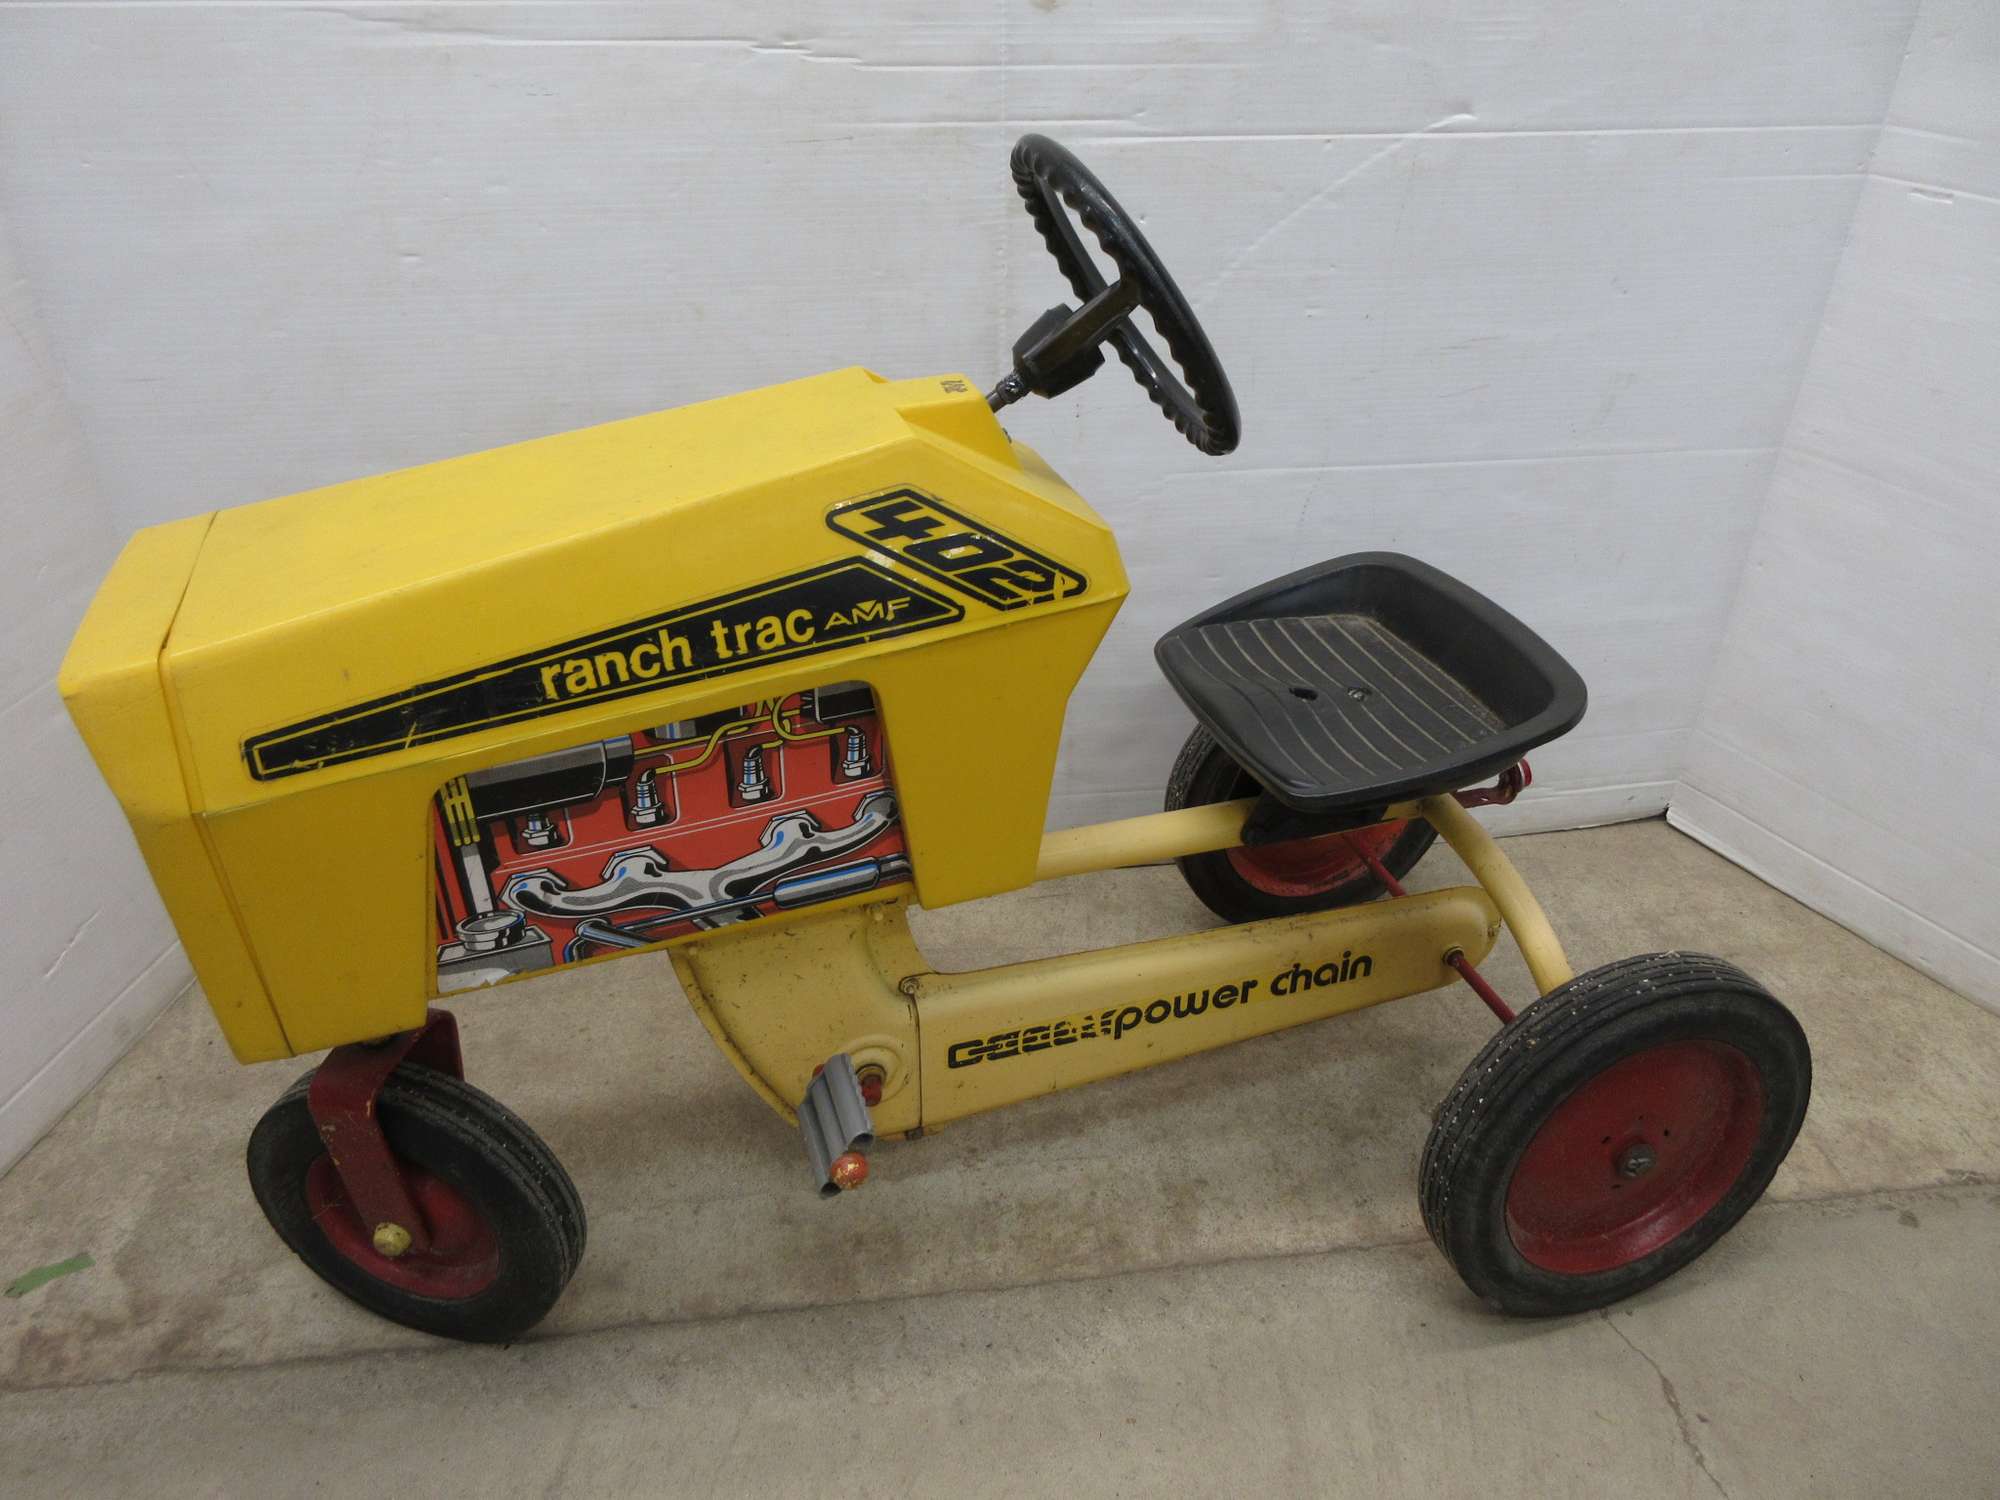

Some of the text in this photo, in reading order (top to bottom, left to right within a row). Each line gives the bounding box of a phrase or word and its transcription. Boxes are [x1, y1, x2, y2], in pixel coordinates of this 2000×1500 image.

[861, 500, 1056, 600] 402
[541, 597, 911, 701] ranch trac AMF
[1114, 950, 1374, 1040] power chain
